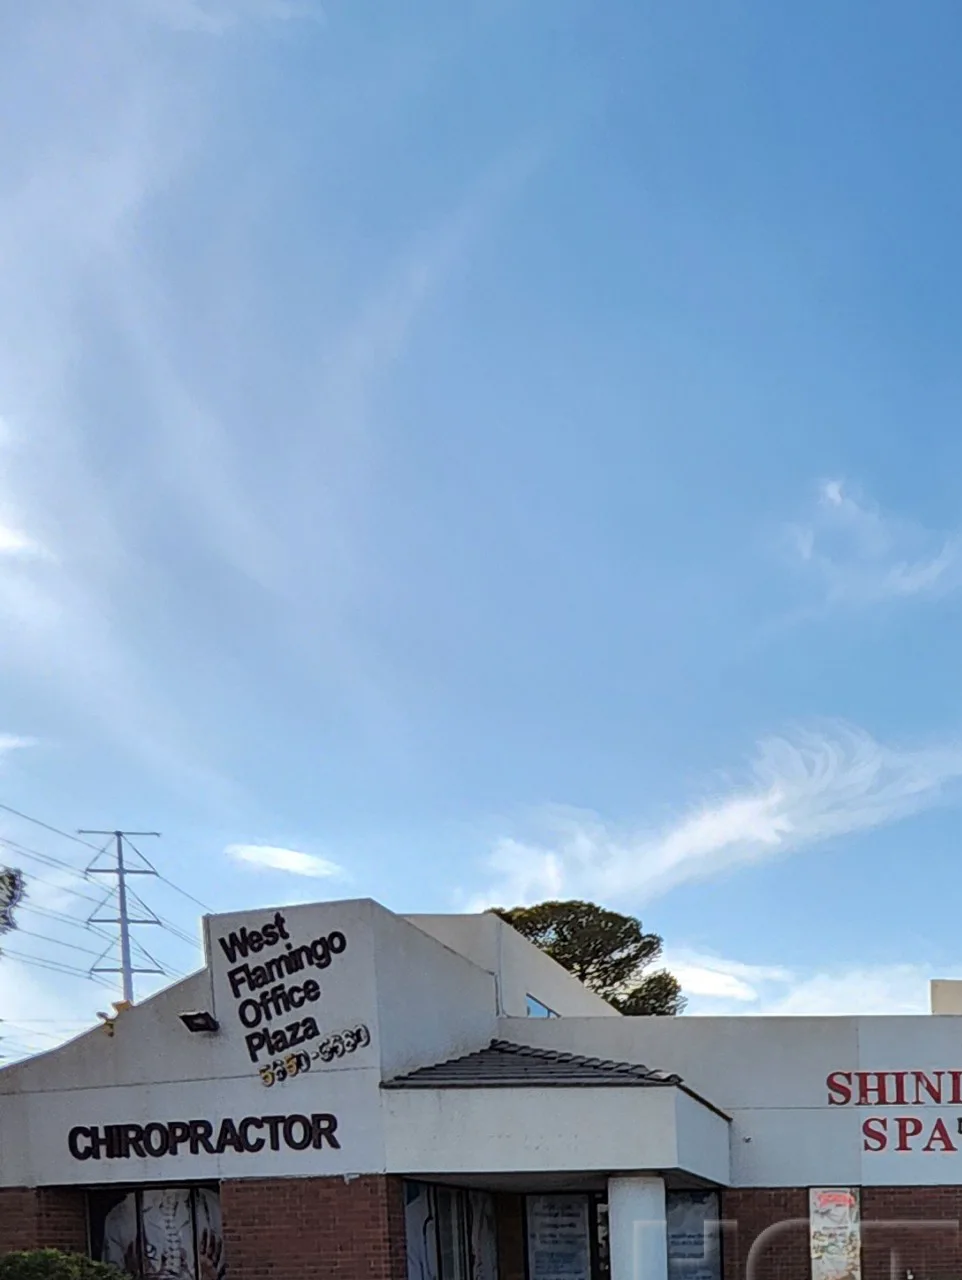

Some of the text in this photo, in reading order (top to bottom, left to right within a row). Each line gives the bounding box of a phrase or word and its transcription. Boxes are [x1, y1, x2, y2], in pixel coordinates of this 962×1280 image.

[218, 912, 289, 963] West
[227, 931, 347, 998] Flamingo
[238, 979, 321, 1028] Office
[245, 1017, 320, 1062] Plaza
[68, 1113, 340, 1160] CHIROPRACTOR
[862, 1117, 958, 1152] SPA
